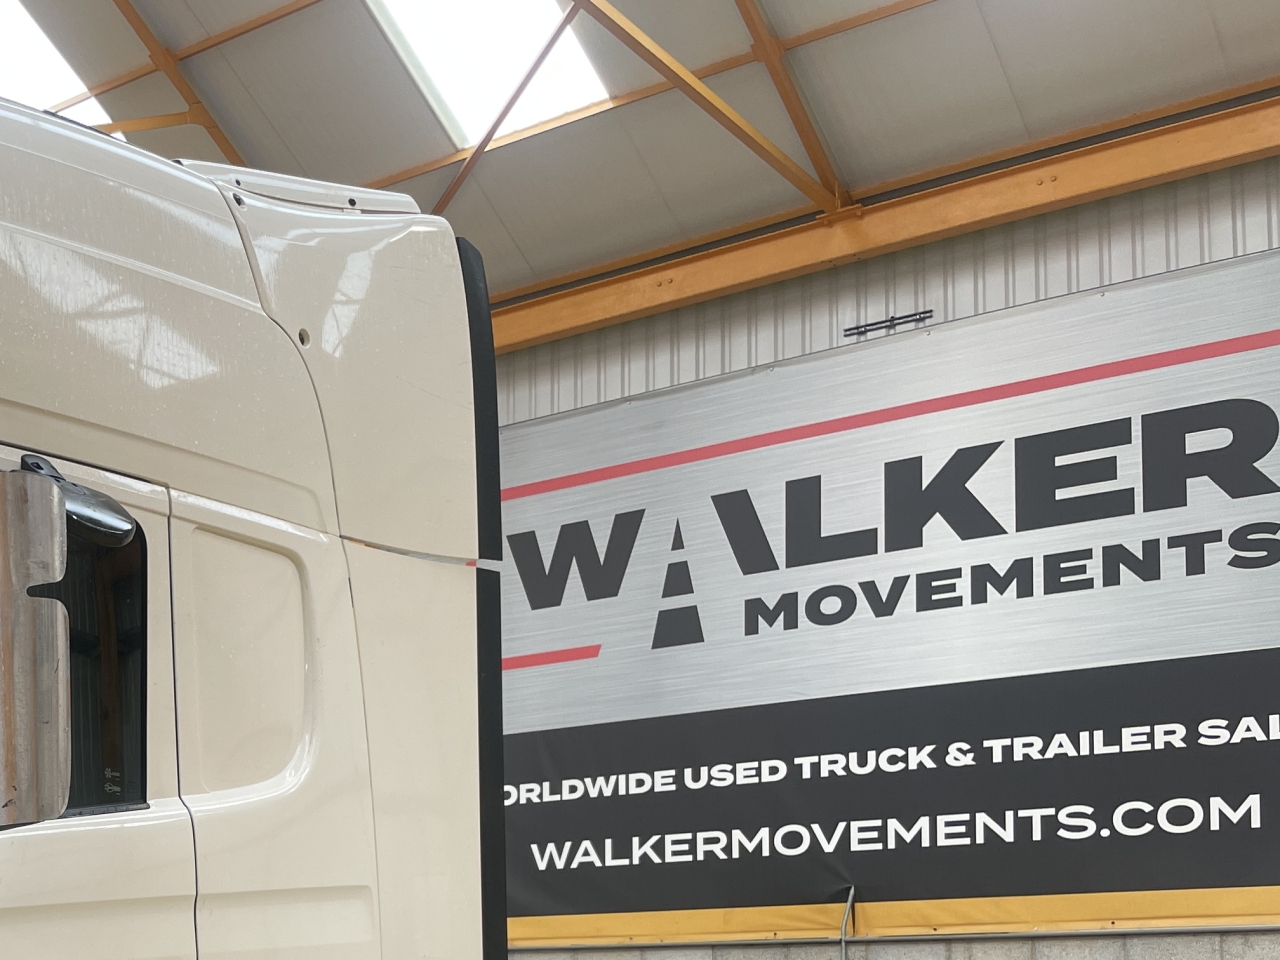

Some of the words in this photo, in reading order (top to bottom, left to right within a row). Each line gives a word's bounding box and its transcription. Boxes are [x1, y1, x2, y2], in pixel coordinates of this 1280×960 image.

[507, 398, 1280, 650] WALKER
[743, 522, 1280, 636] MOVEMENTS
[683, 758, 787, 790] USED
[793, 743, 936, 779] TRUCK
[945, 740, 976, 766] &
[981, 722, 1188, 761] TRAILER
[530, 794, 1263, 871] WALKERMOVEMENTS.COM
